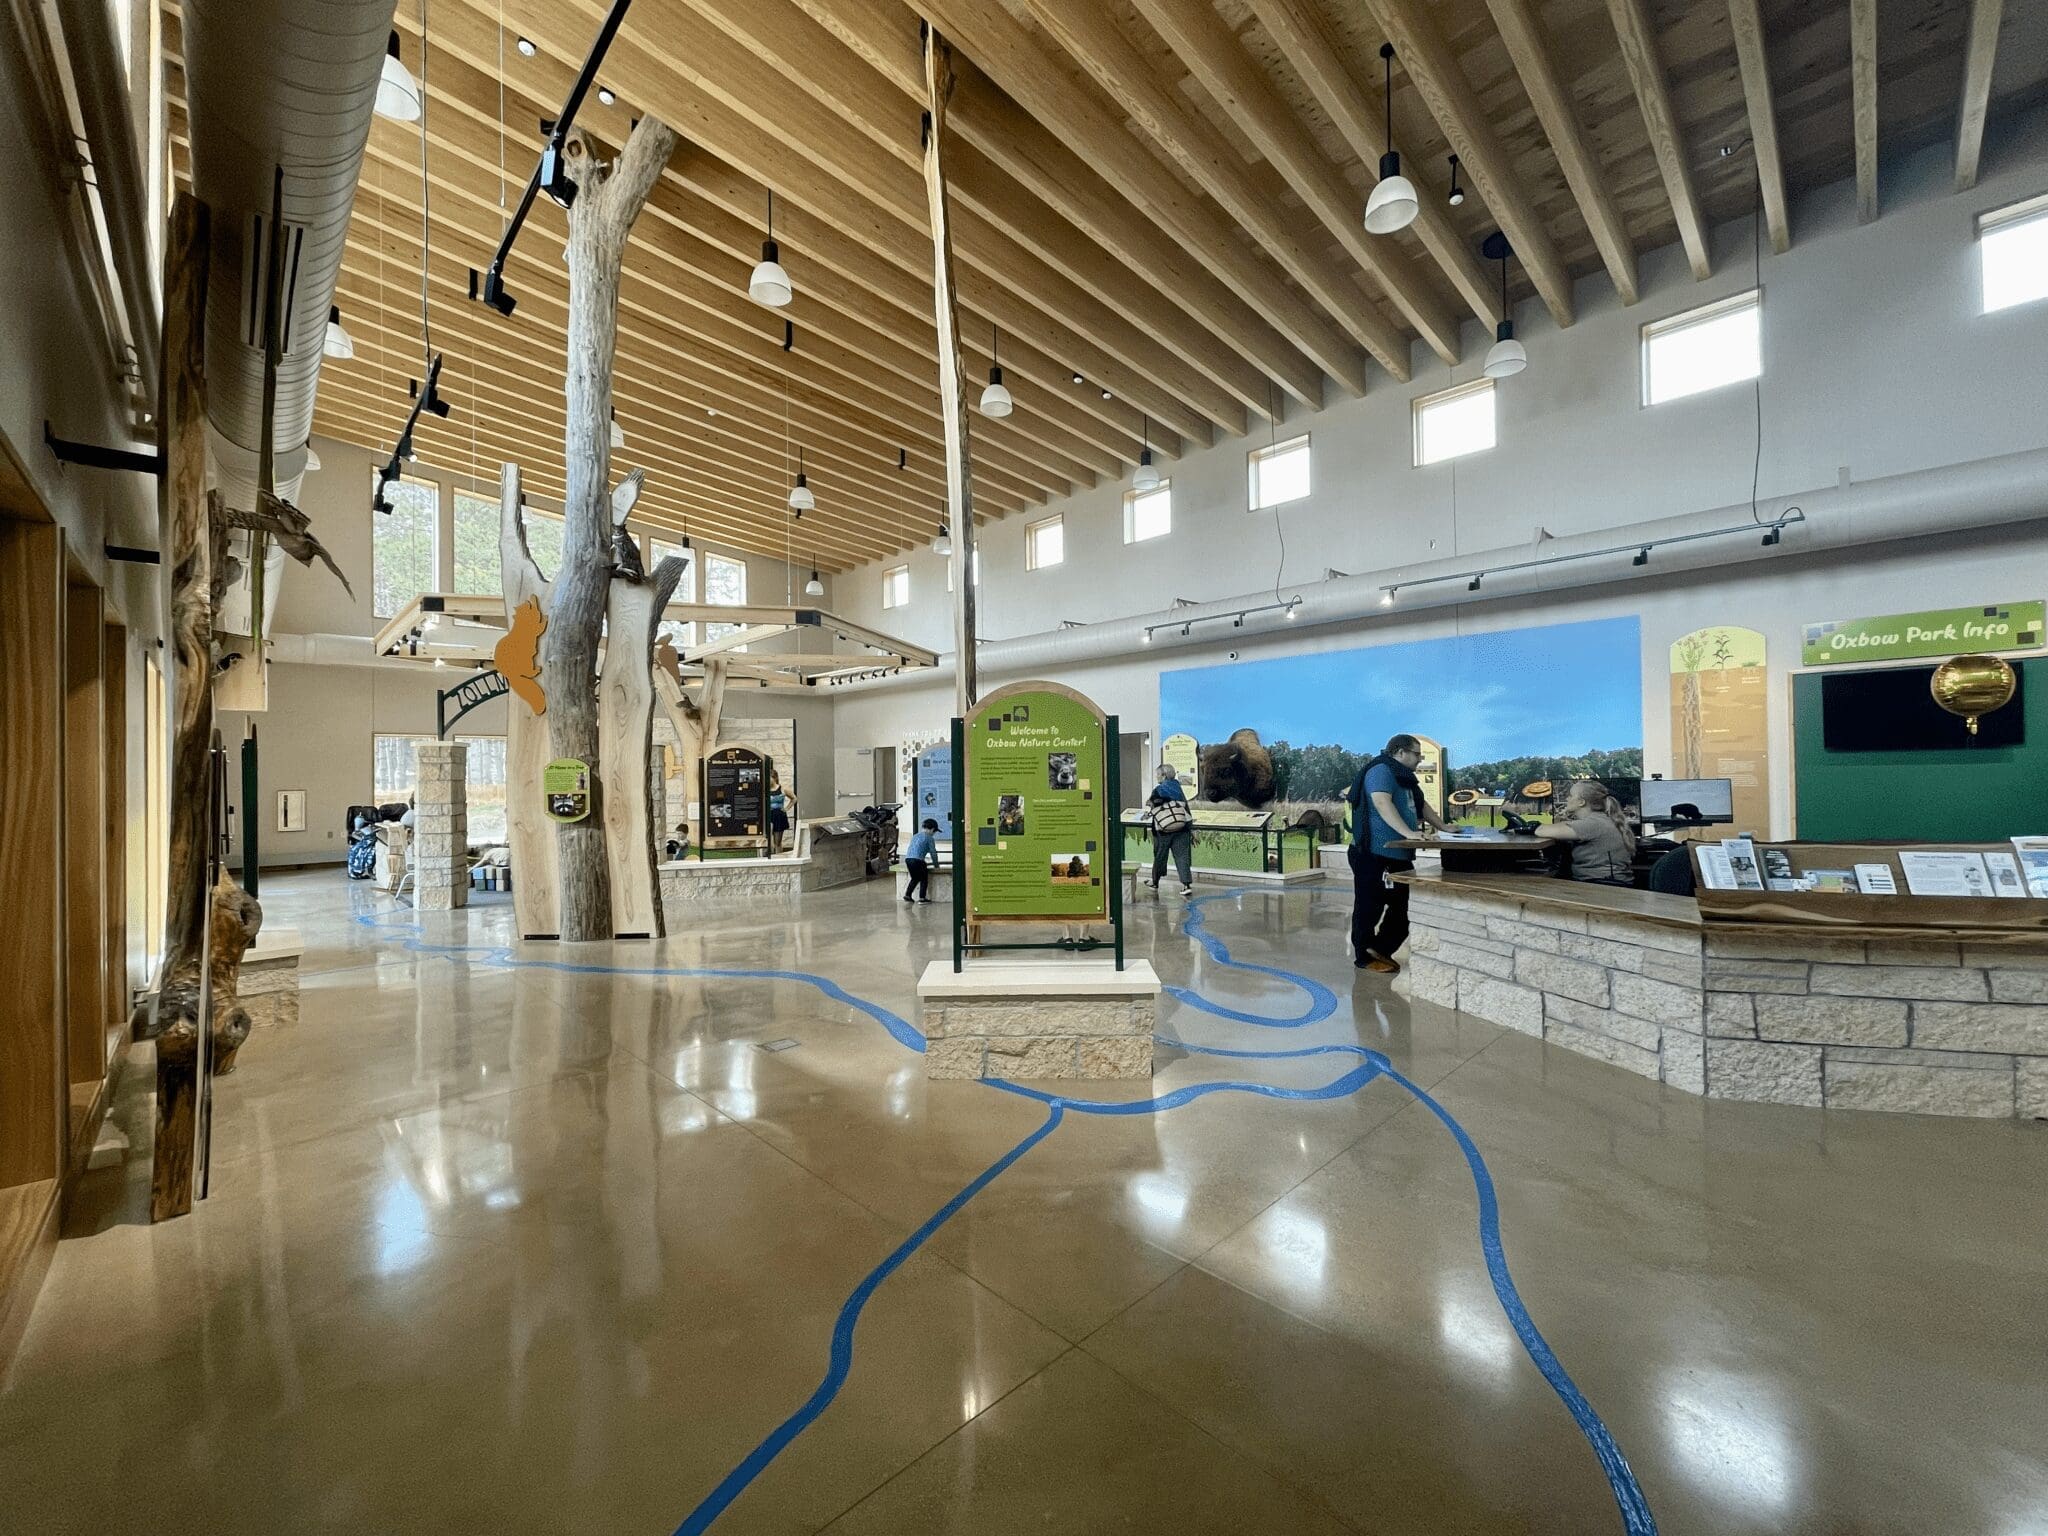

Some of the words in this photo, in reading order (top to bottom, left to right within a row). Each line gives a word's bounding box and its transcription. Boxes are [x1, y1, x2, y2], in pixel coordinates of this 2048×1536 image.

[1831, 632, 1899, 649] Oxbow
[1906, 624, 1958, 643] Park
[1963, 621, 2009, 640] Info
[1010, 726, 1048, 736] Welcome
[1050, 725, 1059, 735] to
[987, 738, 1017, 748] Oxbow
[1019, 738, 1050, 747] Nature
[1053, 736, 1087, 747] Center!
